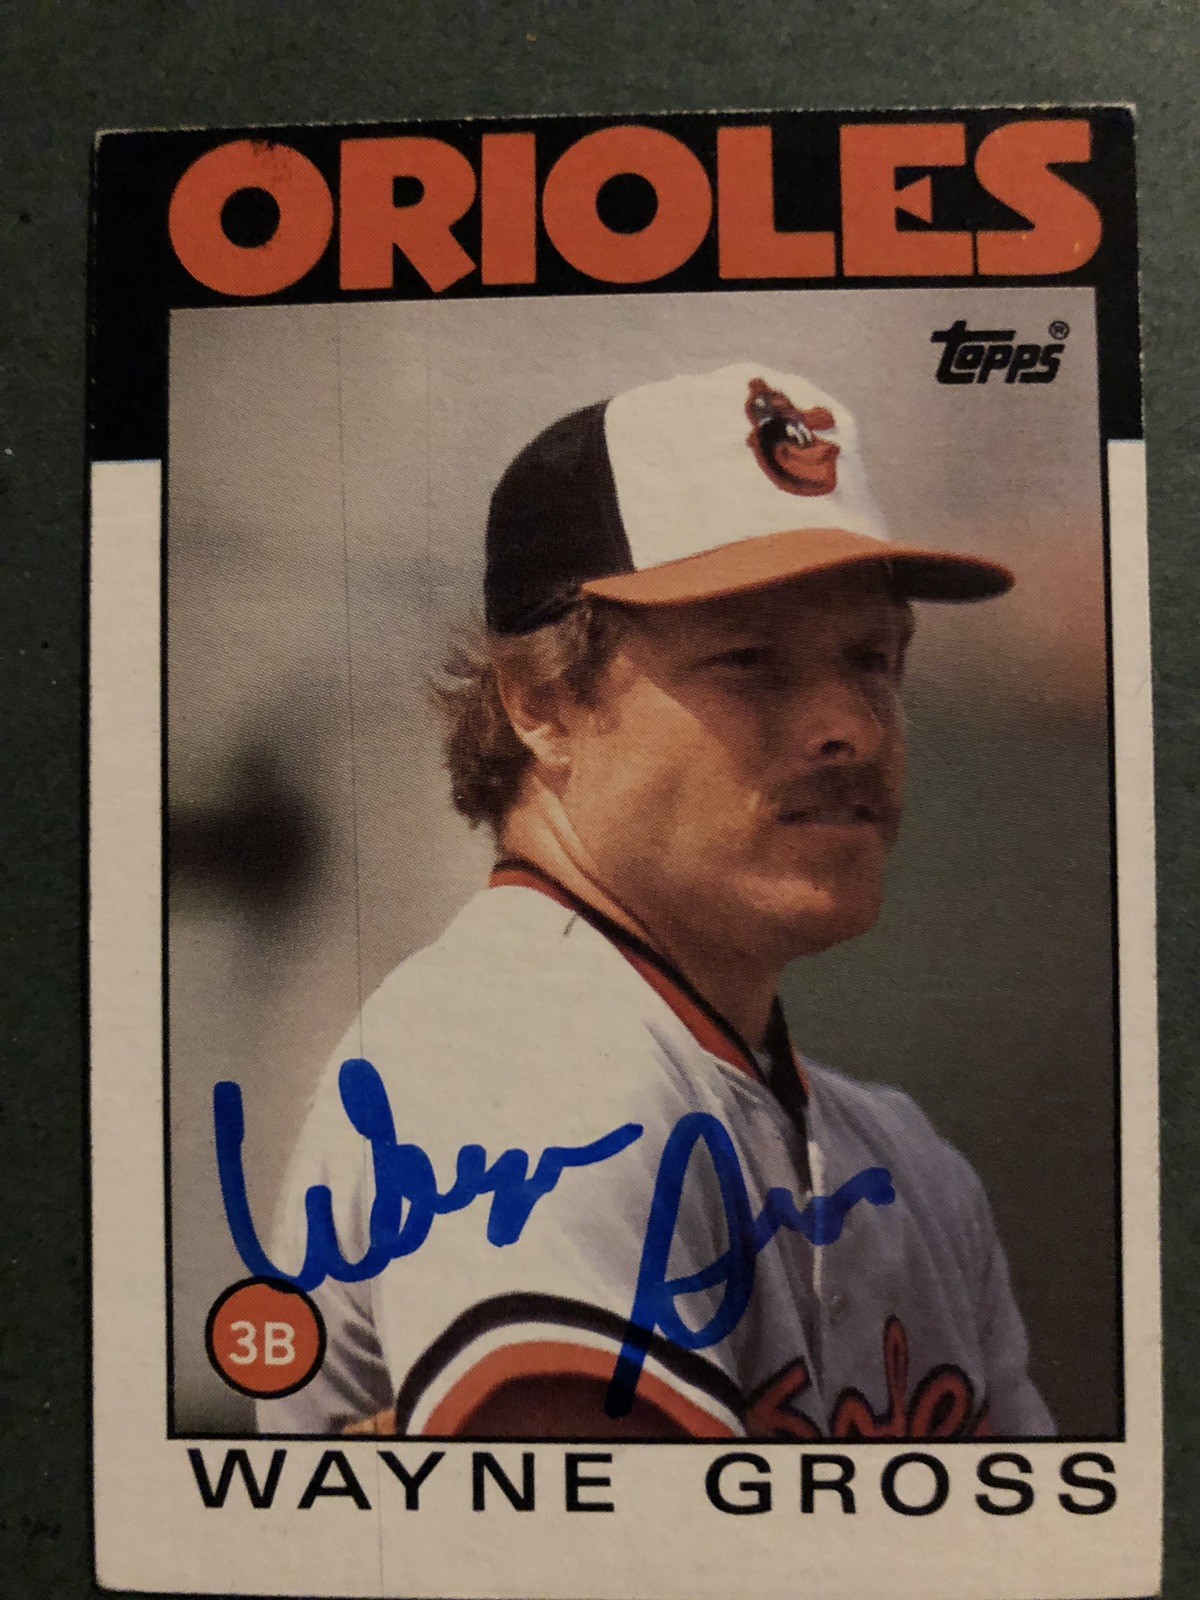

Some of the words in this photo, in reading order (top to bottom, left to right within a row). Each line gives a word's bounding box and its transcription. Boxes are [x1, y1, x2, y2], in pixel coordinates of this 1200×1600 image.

[168, 119, 1104, 297] ORIOLES
[228, 1320, 296, 1366] 3B
[187, 1448, 615, 1513] WAYNE
[705, 1452, 1118, 1517] GROSS
